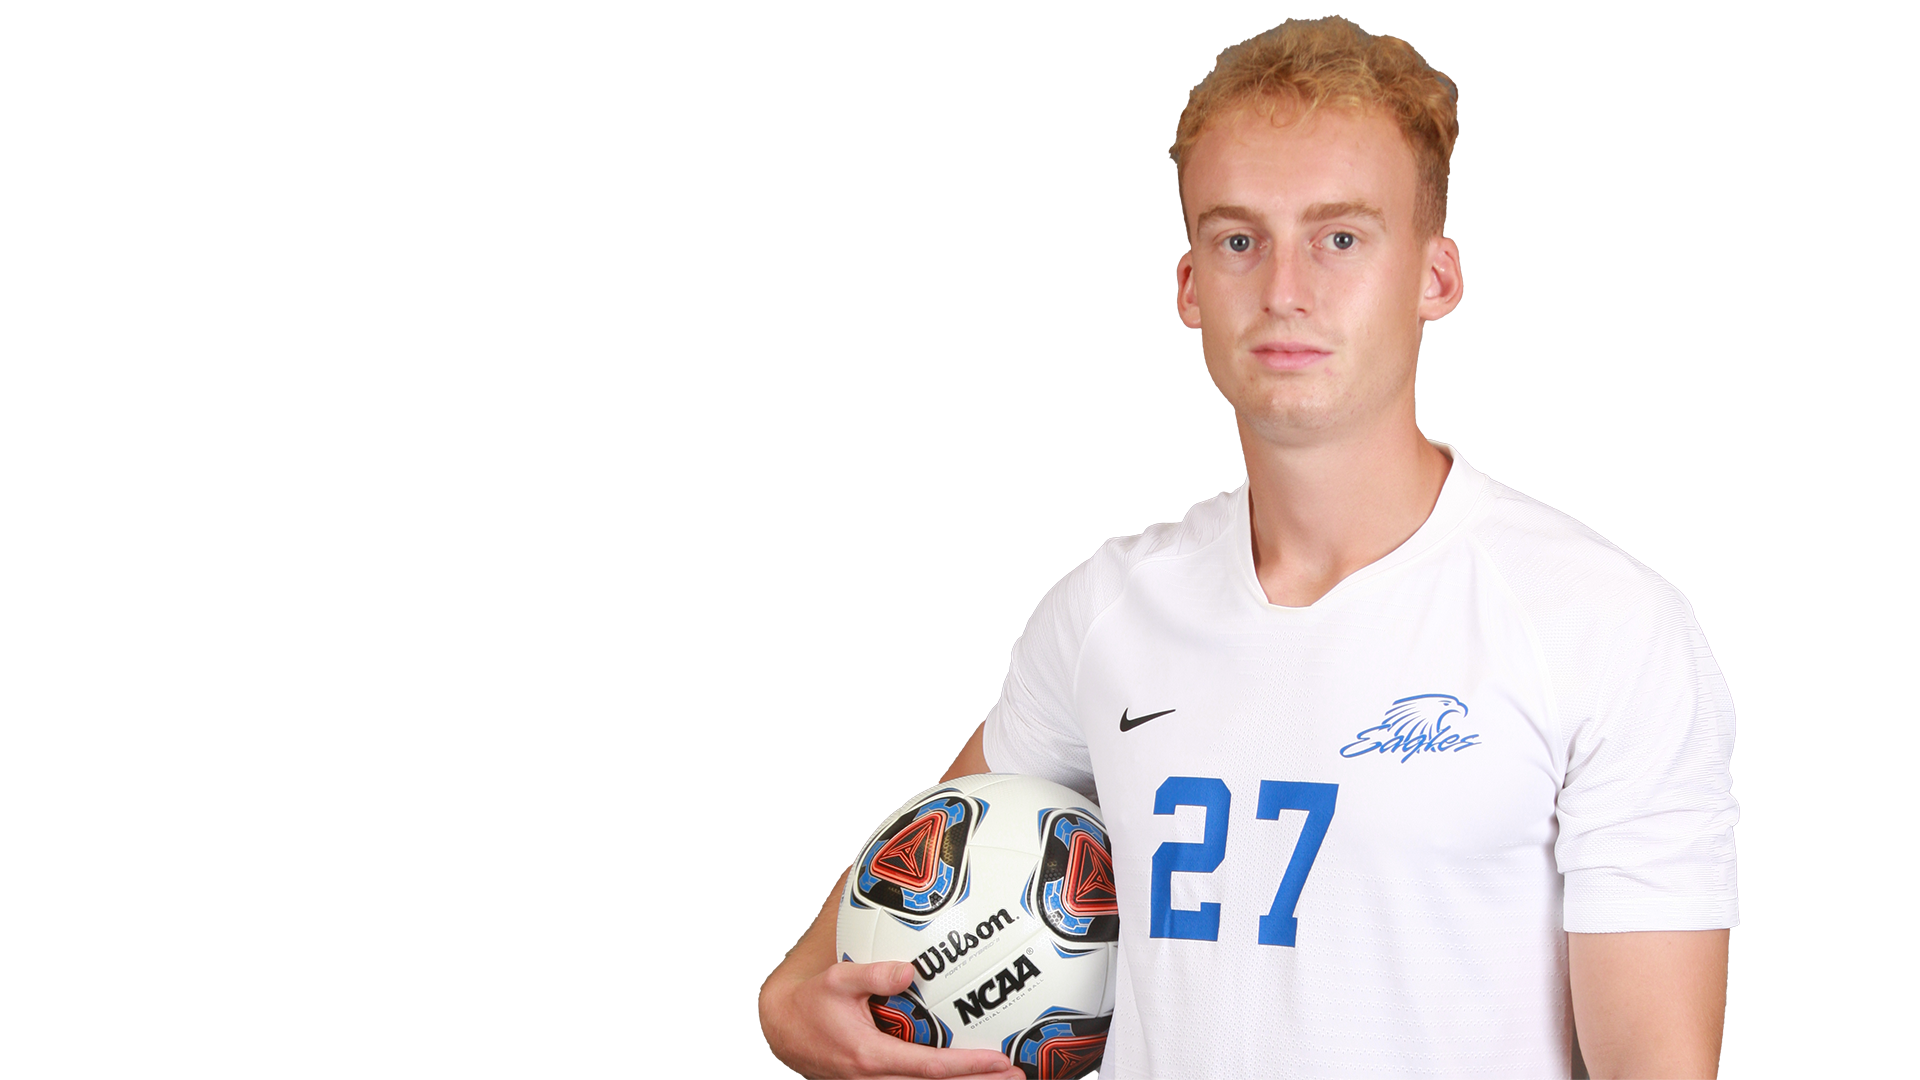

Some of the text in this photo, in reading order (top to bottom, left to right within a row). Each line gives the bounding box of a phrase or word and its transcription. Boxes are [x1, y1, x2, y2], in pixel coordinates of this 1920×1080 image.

[1340, 723, 1482, 764] Eagles
[1150, 776, 1339, 948] 27
[911, 908, 1016, 981] Wilson
[953, 954, 1042, 1026] NCAA
[970, 978, 1044, 1030] OFFICIAL MATCH BALL
